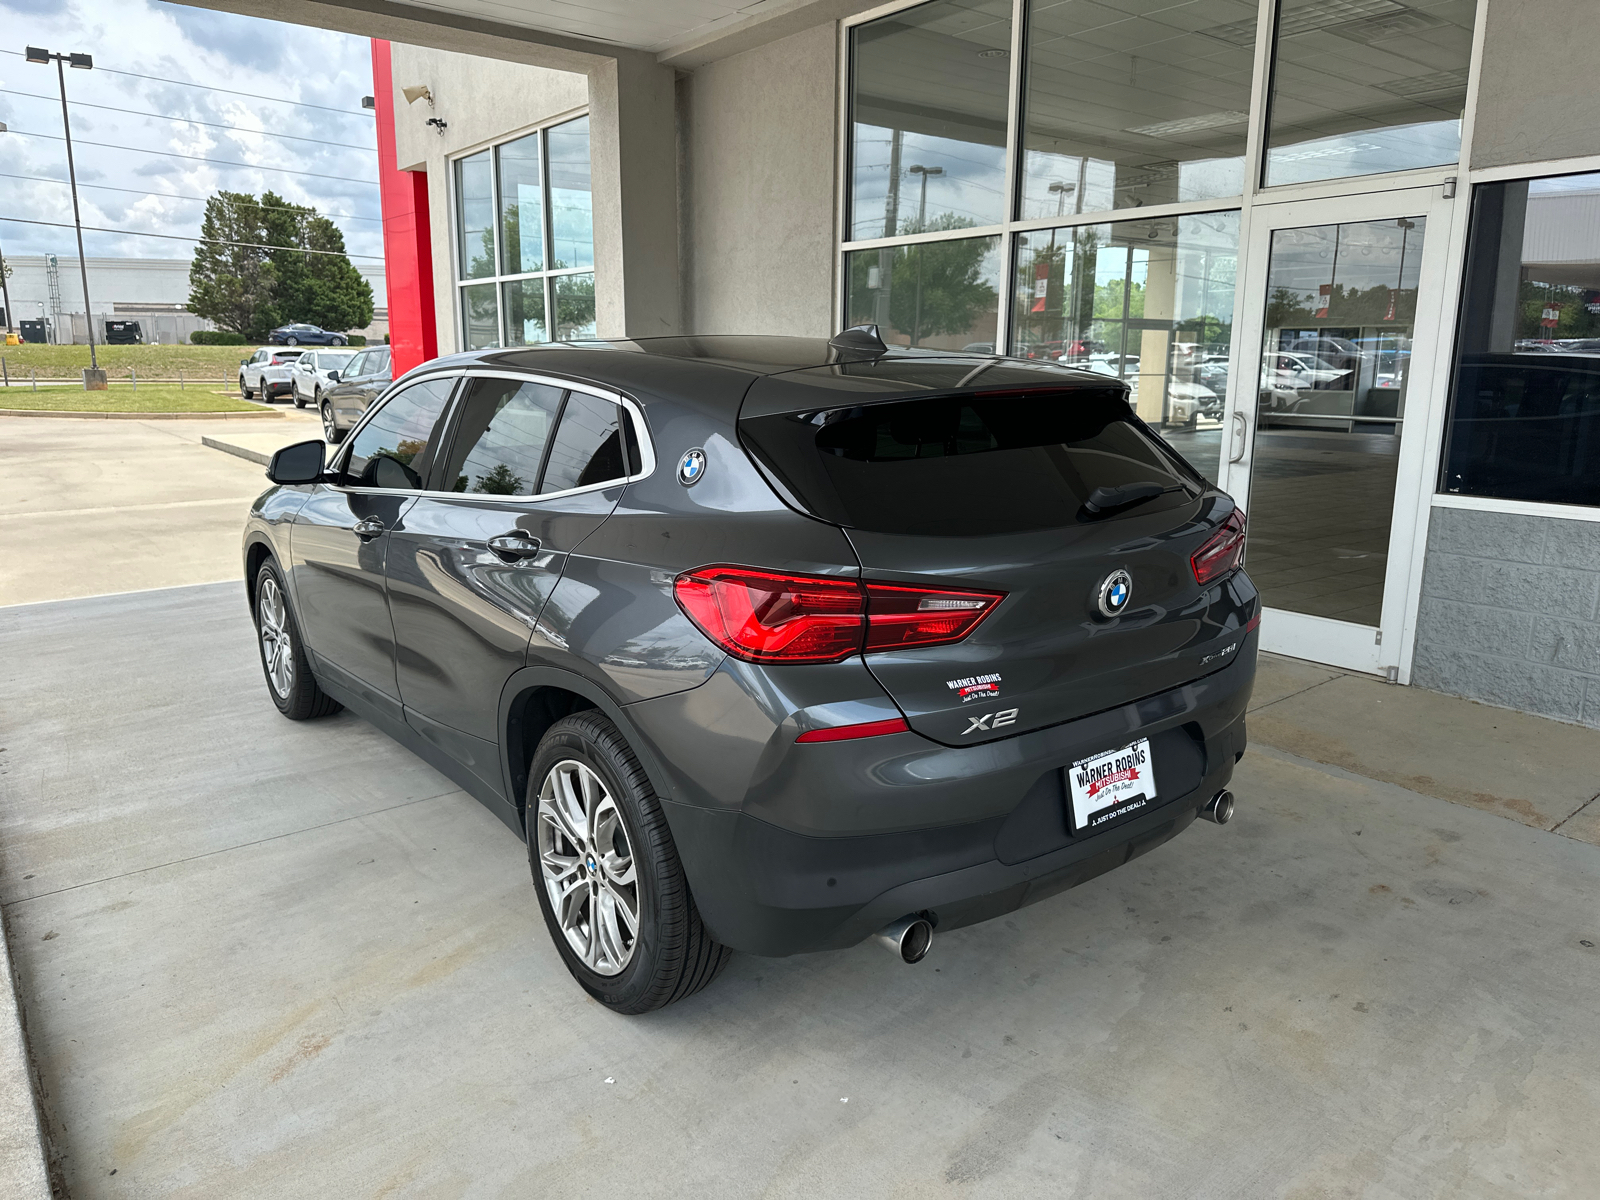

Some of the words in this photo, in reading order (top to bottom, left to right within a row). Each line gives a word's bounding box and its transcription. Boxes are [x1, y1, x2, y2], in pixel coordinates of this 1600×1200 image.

[946, 677, 977, 690] WARNER
[976, 673, 1002, 684] ROBINS
[960, 708, 1020, 736] X2
[1076, 761, 1113, 788] WARNER
[1115, 750, 1146, 772] ROBINS
[1095, 770, 1131, 790] MITSUBISHI
[1095, 790, 1105, 802] Just
[1105, 787, 1111, 796] Do
[1112, 784, 1120, 793] The
[1121, 782, 1135, 790] Deal!
[1097, 814, 1109, 825] JUST
[1117, 807, 1127, 816] THE
[1127, 801, 1142, 811] DEAL!
